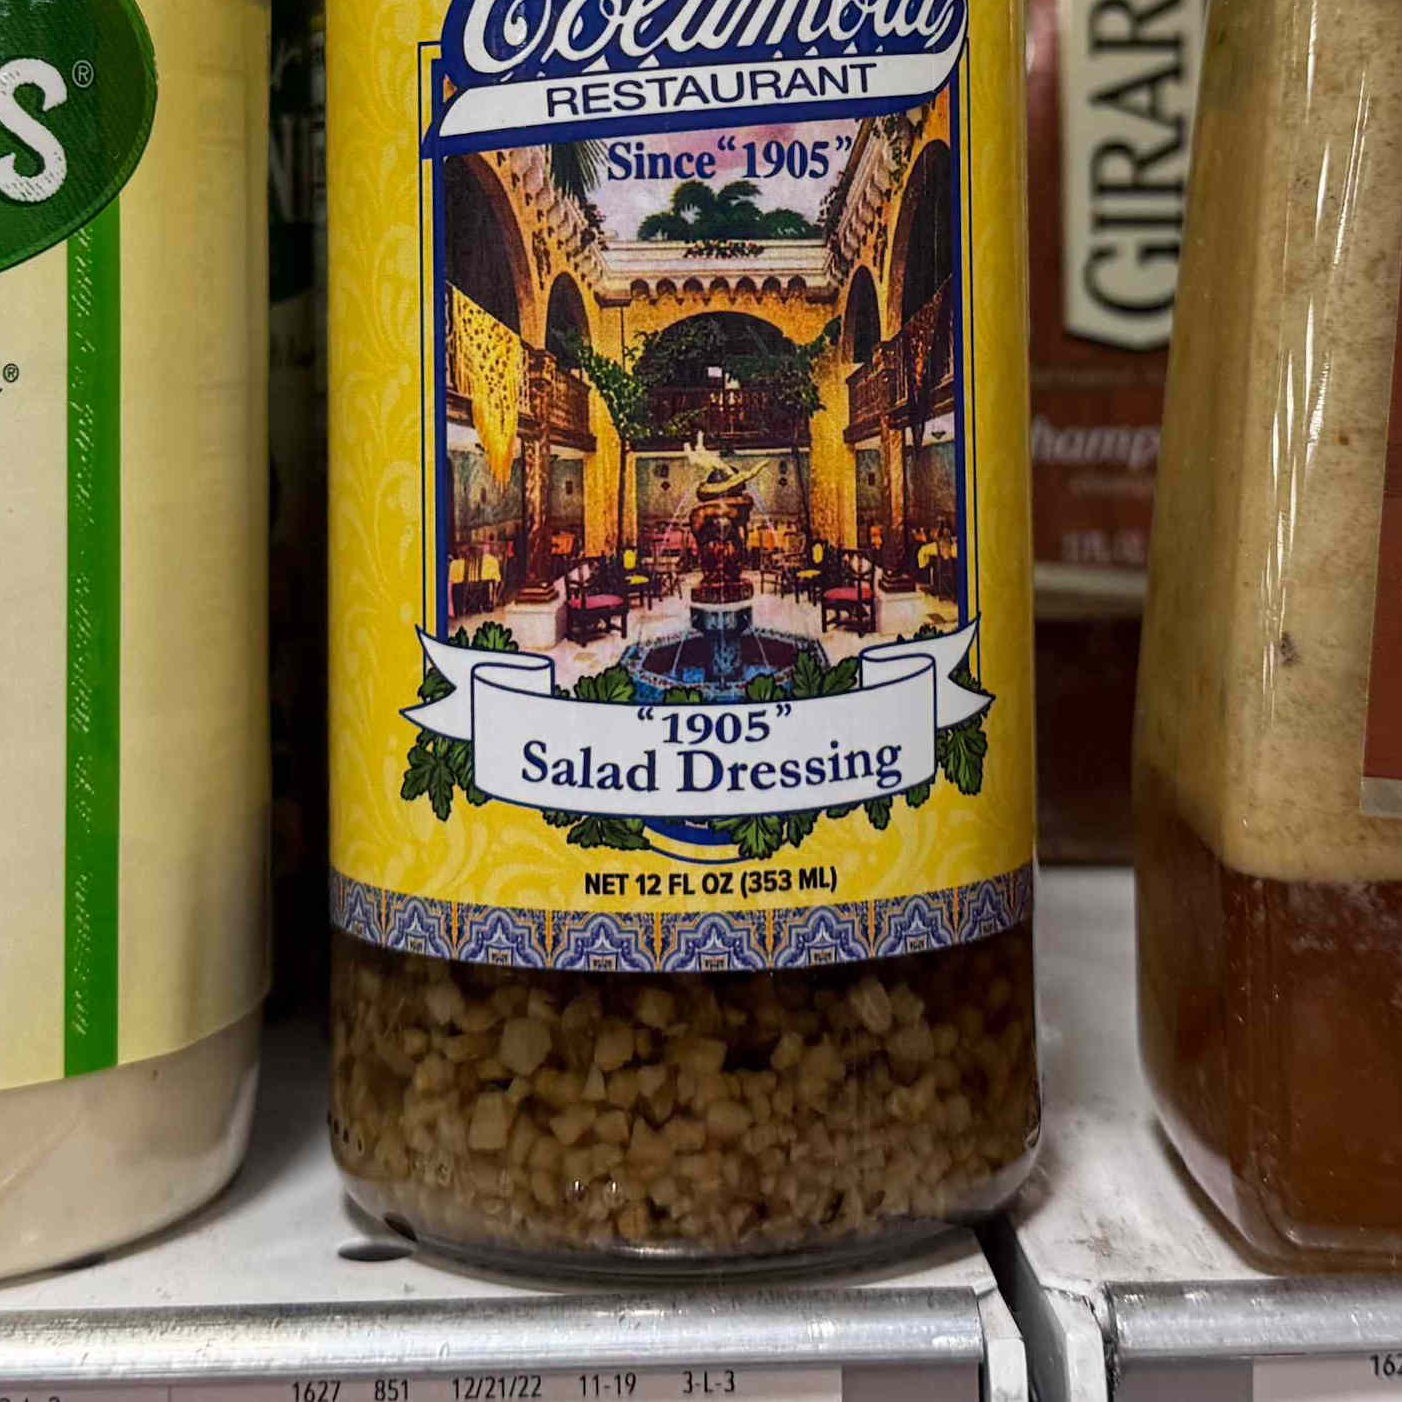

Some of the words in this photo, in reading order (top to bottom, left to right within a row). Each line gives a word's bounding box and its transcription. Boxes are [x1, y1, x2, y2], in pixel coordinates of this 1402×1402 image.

[547, 62, 878, 118] RESTAURANT
[607, 141, 716, 181] Since
[522, 740, 658, 793] Salad
[676, 740, 902, 792] Dressing
[584, 872, 632, 896] NET
[637, 873, 663, 896] 12
[668, 872, 696, 896] FL
[701, 872, 734, 896] OZ
[740, 869, 793, 899] (353
[798, 866, 837, 895] ML)
[292, 1379, 341, 1402] 1627
[374, 1378, 411, 1402] 851
[451, 1374, 543, 1400] 12/21/22
[578, 1372, 637, 1397] 11-19
[682, 1370, 735, 1395] 3-L-3
